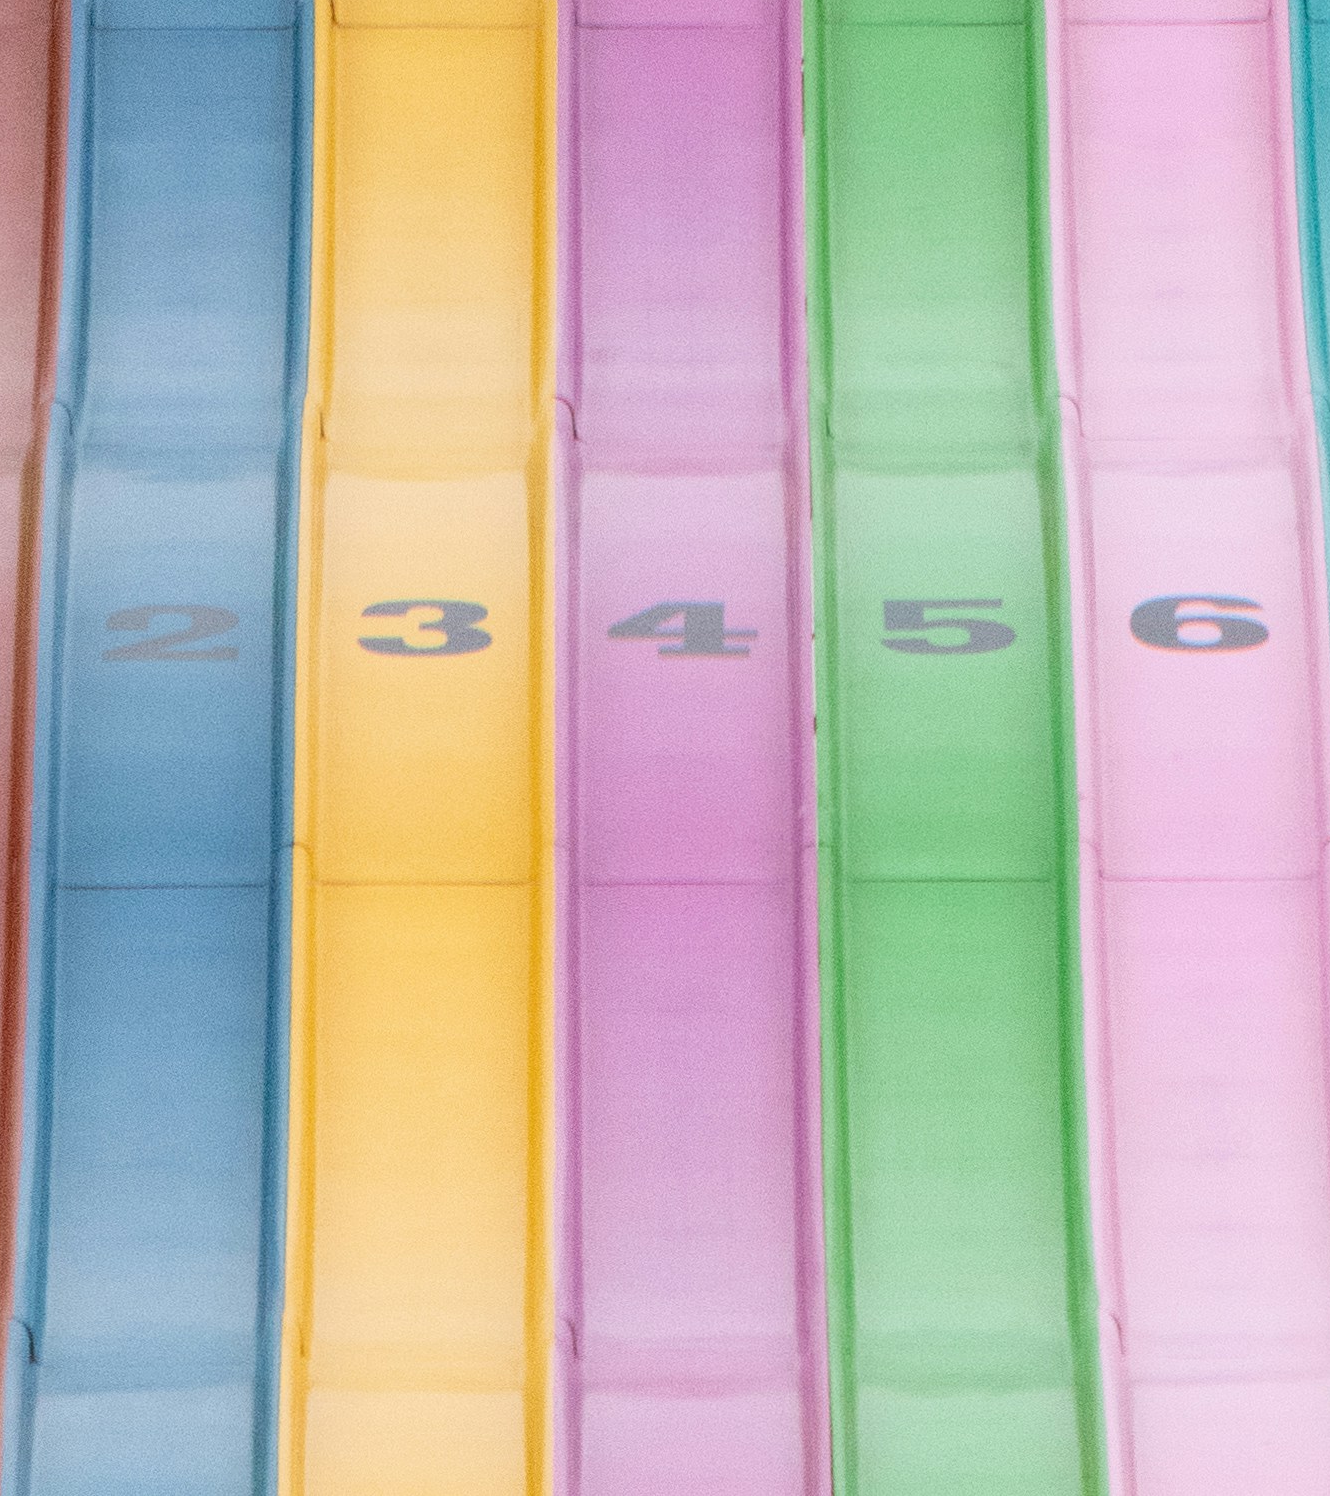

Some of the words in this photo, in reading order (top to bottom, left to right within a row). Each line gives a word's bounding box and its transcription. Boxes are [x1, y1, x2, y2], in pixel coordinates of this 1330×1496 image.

[100, 603, 241, 663] 2
[357, 599, 494, 657] 3
[606, 599, 760, 659] 4
[880, 597, 1017, 656] 5
[1128, 593, 1271, 654] 6
